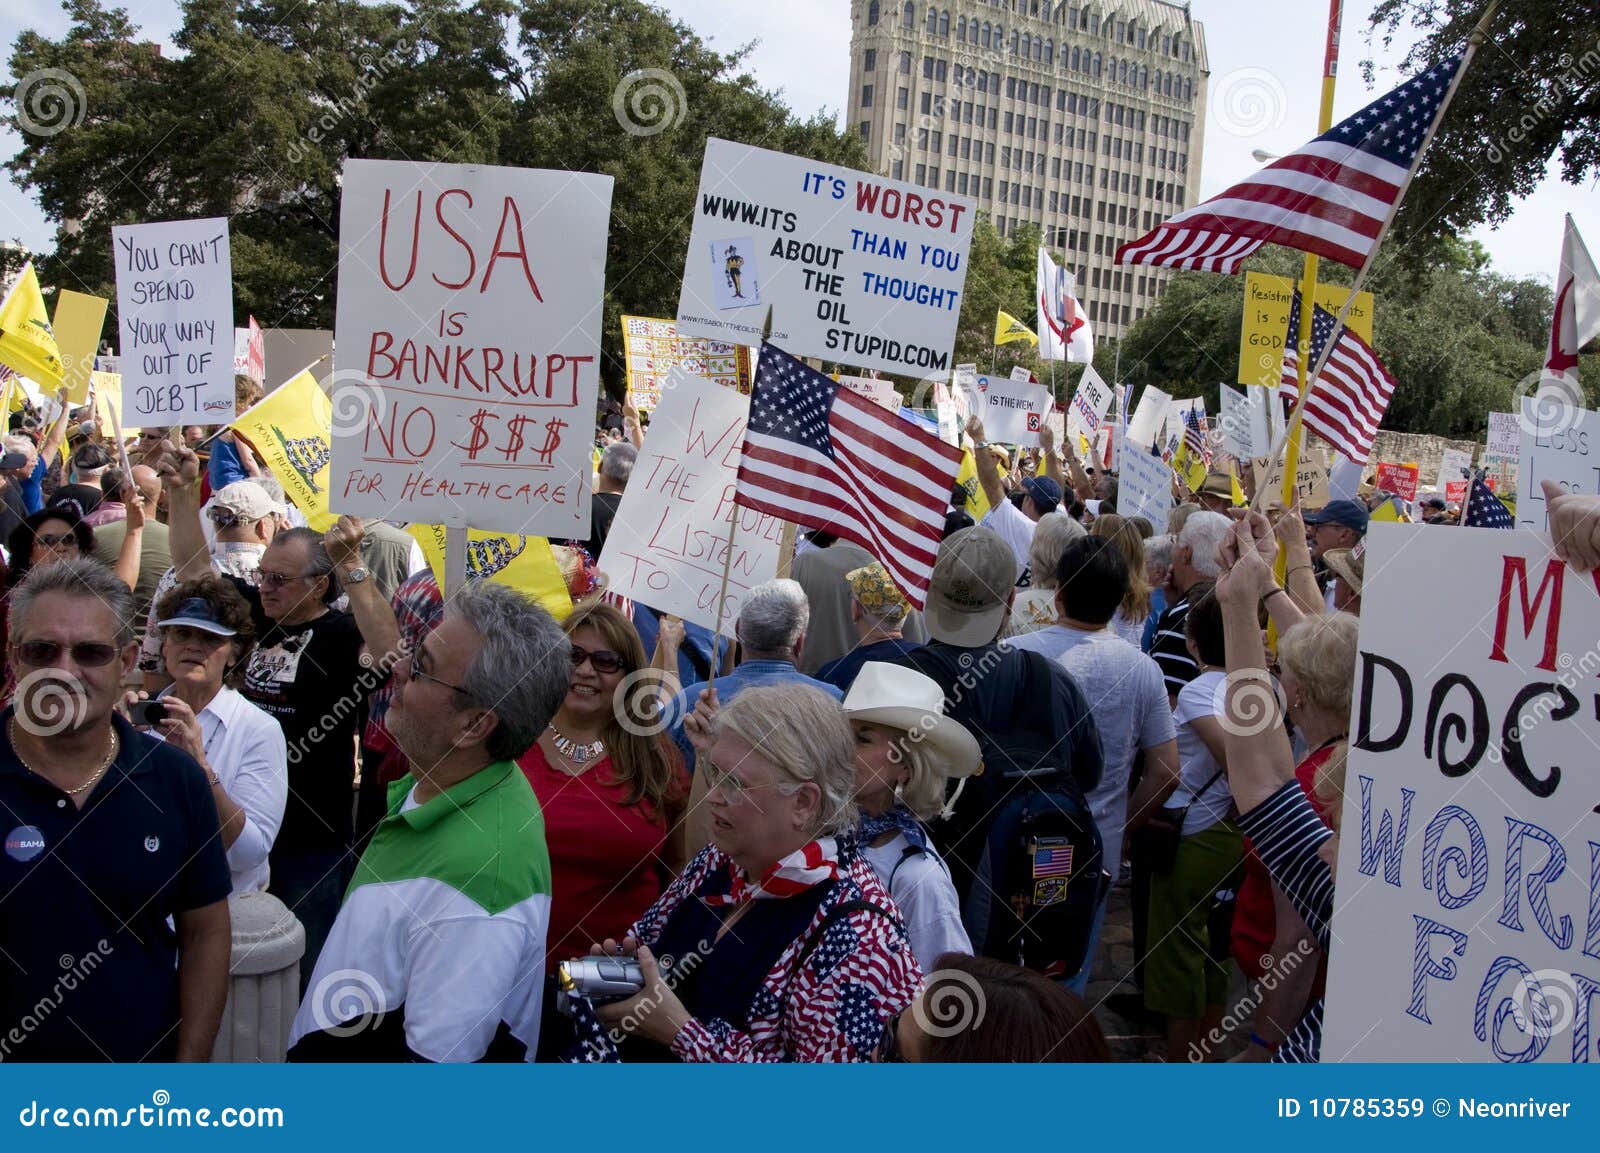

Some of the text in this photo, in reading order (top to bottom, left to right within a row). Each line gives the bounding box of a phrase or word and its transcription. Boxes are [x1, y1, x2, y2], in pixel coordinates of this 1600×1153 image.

[702, 194, 797, 233] WWW.ITS
[803, 172, 966, 234] IT'S WORST
[119, 235, 224, 272] YOU CAN'T
[379, 188, 543, 303] USA
[770, 237, 843, 269] ABOUT
[851, 229, 960, 272] THAN YOU
[131, 279, 195, 304] SPEND
[802, 269, 844, 296] THE
[862, 272, 958, 311] THOUGHT
[439, 309, 468, 337] IS
[817, 300, 850, 325] OIL
[1257, 310, 1268, 324] is
[127, 319, 217, 353] YOUR WAY
[825, 328, 948, 370] STUPID.COM
[143, 352, 212, 375] OUT OF
[367, 331, 594, 407] BANKRUPT
[135, 382, 208, 414] DEBT
[990, 395, 999, 406] IS
[1000, 396, 1015, 409] THE
[1085, 381, 1101, 408] FIRE
[364, 401, 569, 464] NO $$$
[687, 397, 749, 470] WE
[273, 451, 297, 482] TREAD
[294, 480, 308, 495] ON
[304, 494, 318, 510] ME
[343, 469, 387, 502] FOR
[646, 454, 699, 503] THE
[648, 506, 762, 577] LISTEN
[619, 551, 670, 589] TO
[698, 584, 740, 619] US
[1352, 650, 1600, 812] DOC
